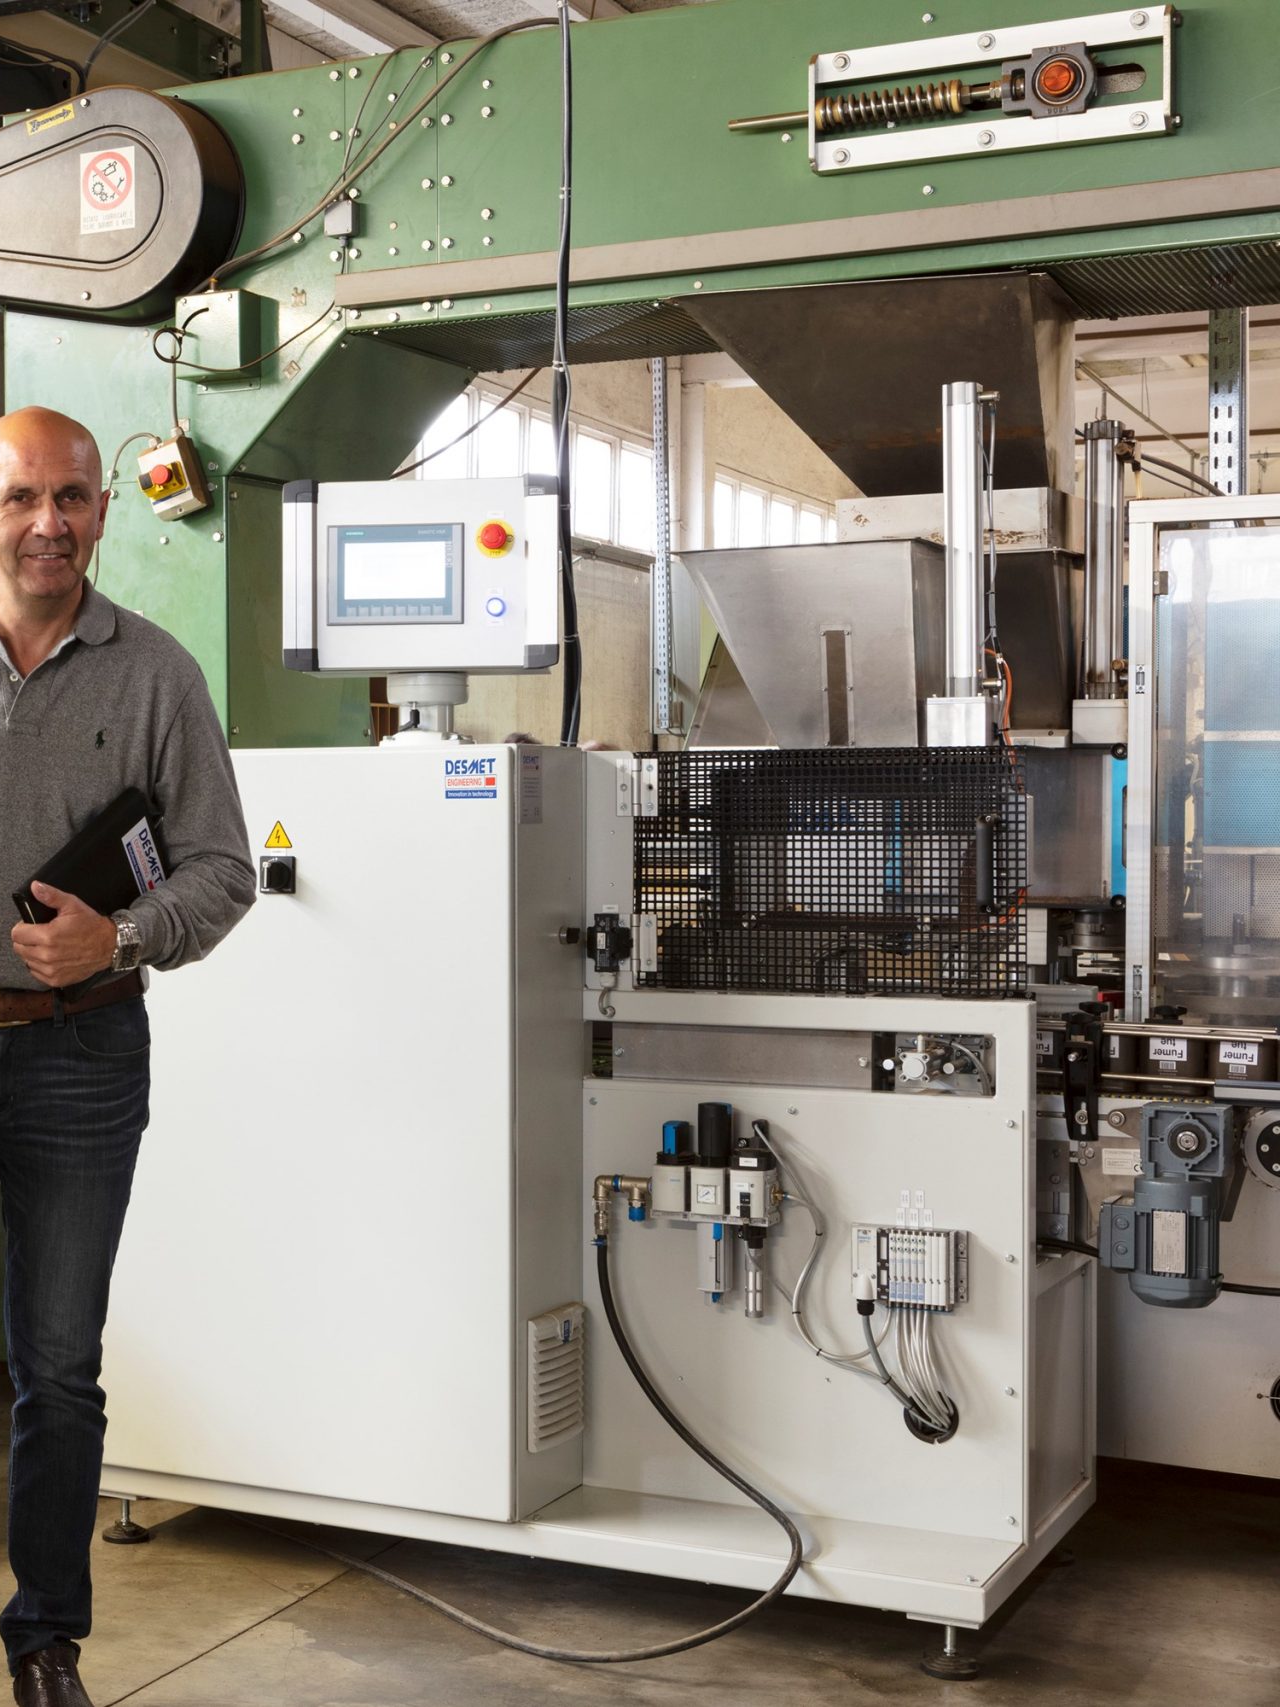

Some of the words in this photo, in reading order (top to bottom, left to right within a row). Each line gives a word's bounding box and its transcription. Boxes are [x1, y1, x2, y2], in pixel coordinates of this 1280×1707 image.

[445, 758, 496, 775] DESMET
[138, 827, 164, 884] DESMET
[1152, 1048, 1184, 1059] Fumer
[1223, 1051, 1254, 1063] Fumer
